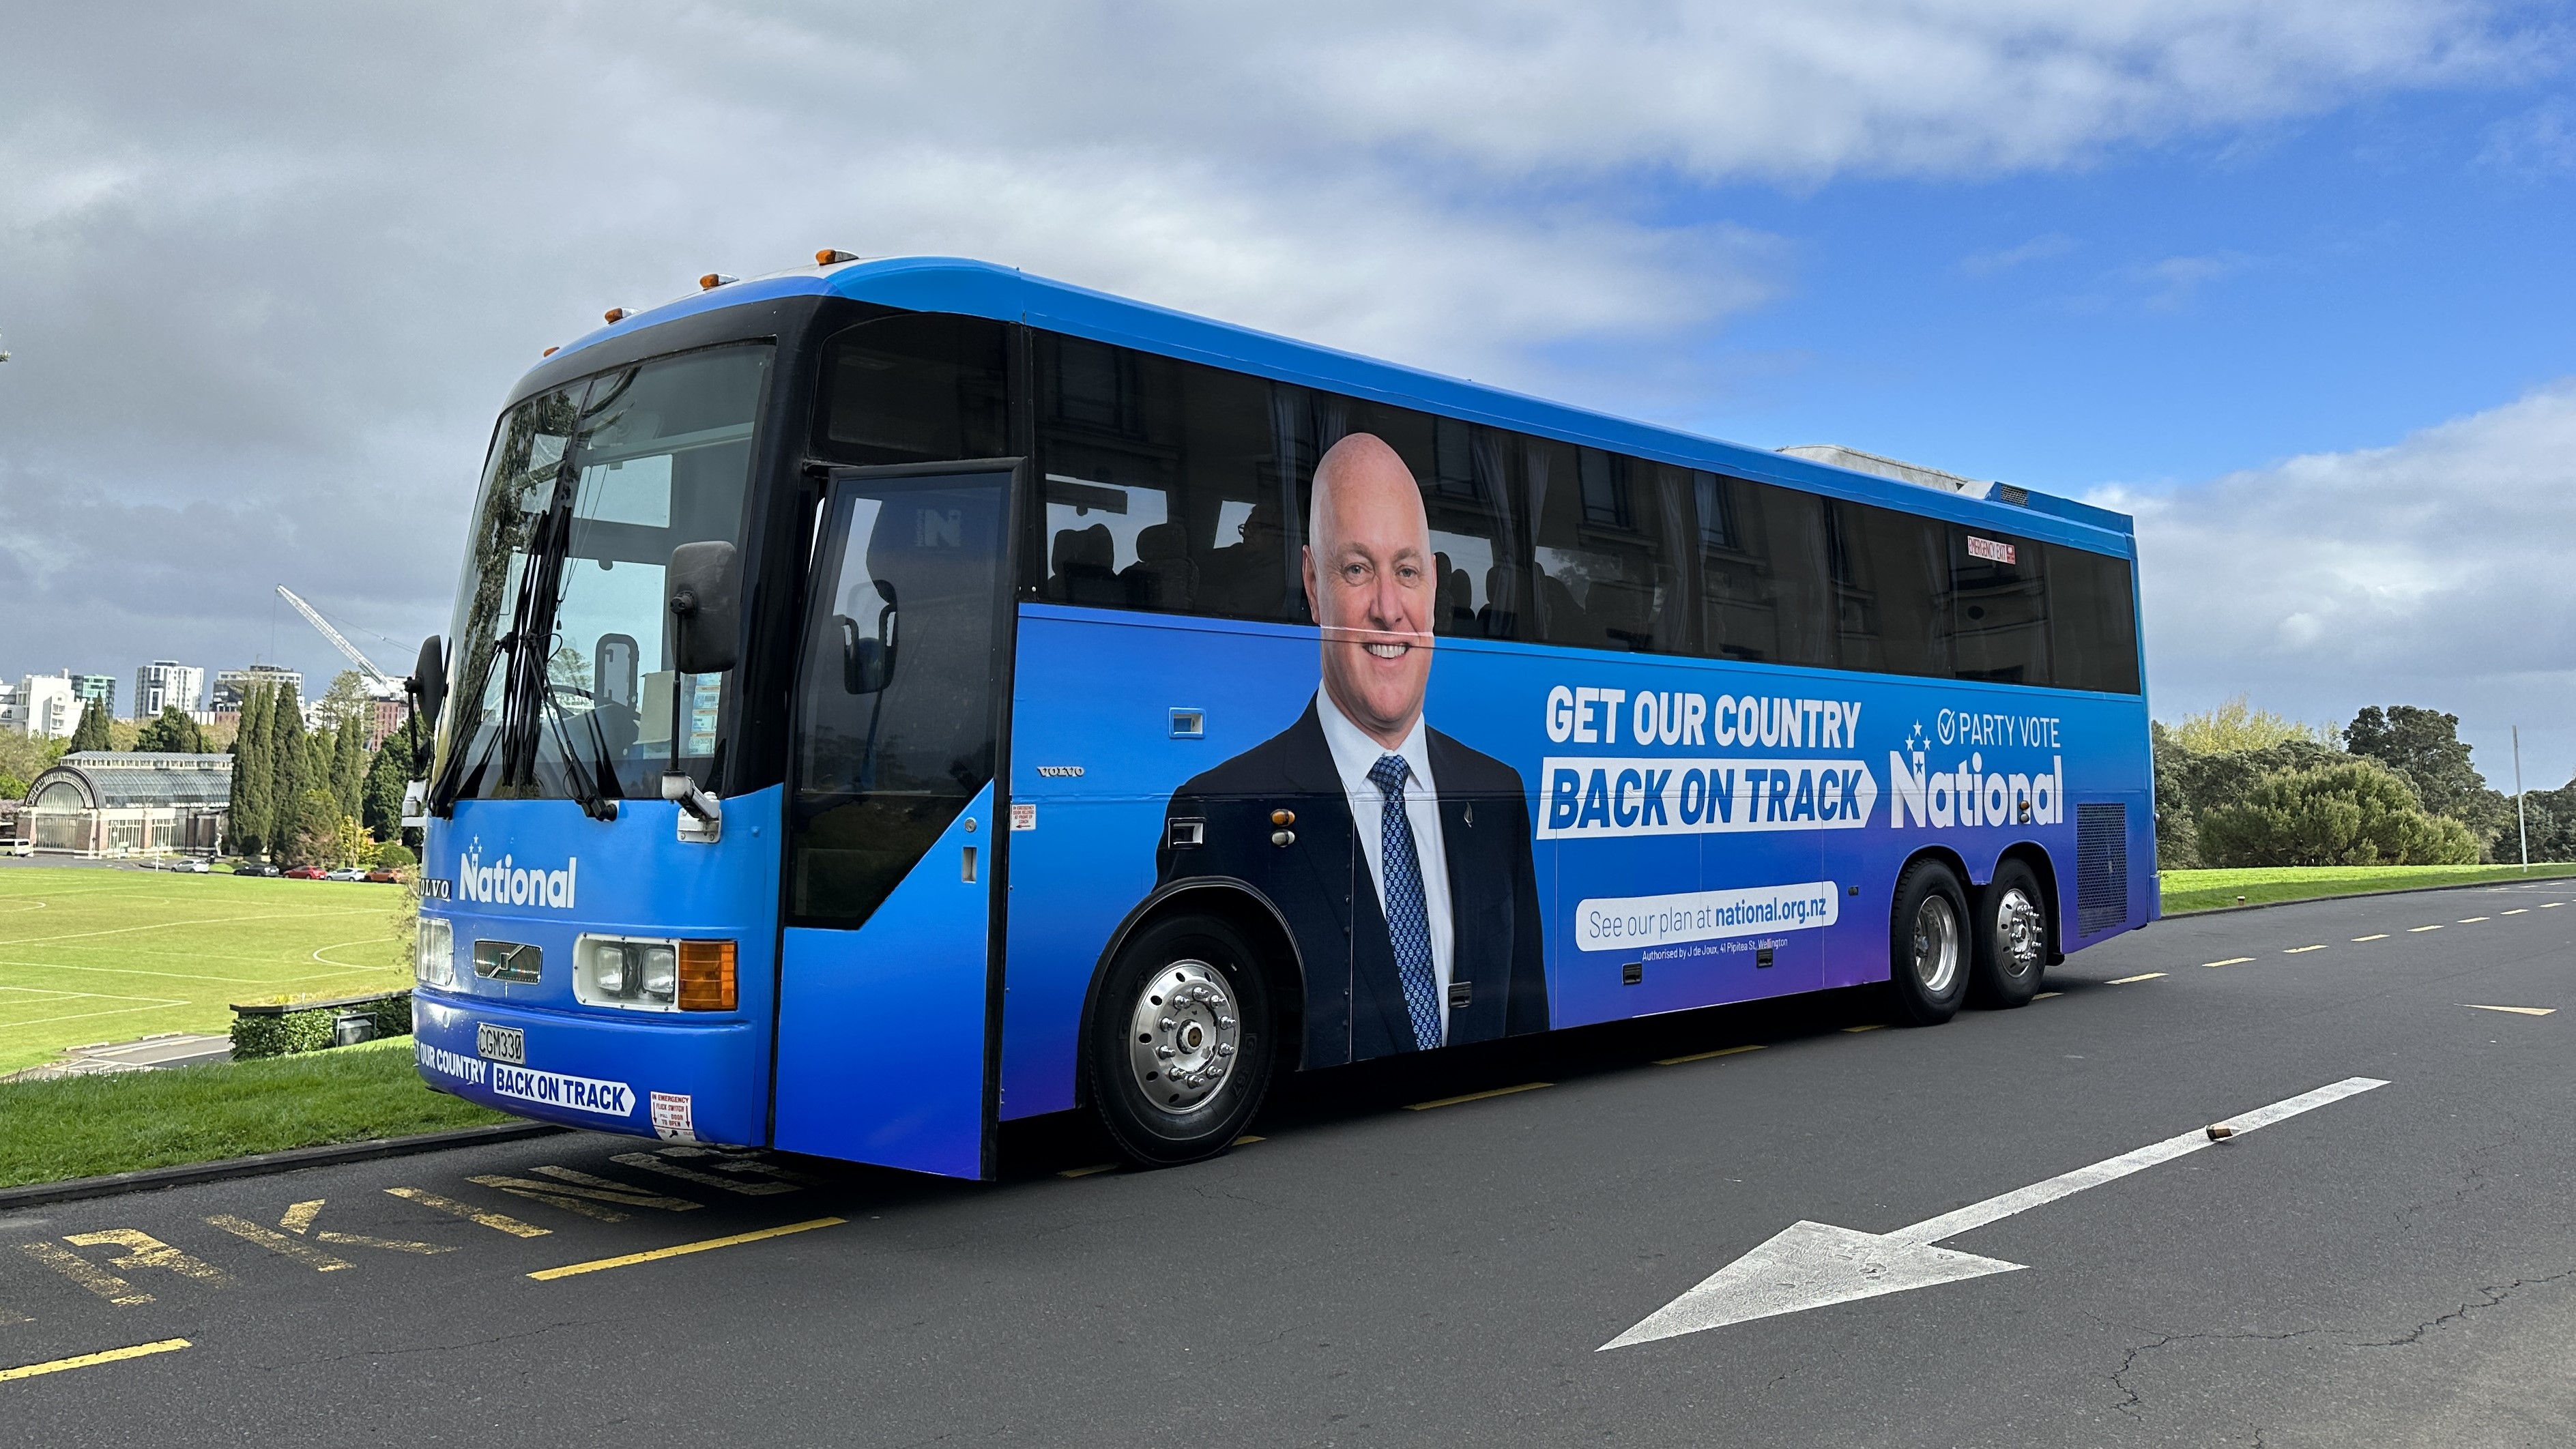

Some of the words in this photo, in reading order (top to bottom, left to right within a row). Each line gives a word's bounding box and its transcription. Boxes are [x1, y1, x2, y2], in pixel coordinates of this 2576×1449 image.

[1969, 538, 1995, 557] EMERGENCY
[1997, 543, 2006, 559] EXIT
[1546, 685, 1625, 744] GET
[1633, 690, 1706, 746] OUR
[1714, 694, 1862, 748] COUNTRY
[1959, 712, 2014, 746] PARTY
[2019, 716, 2061, 748] VOTE
[1037, 766, 1085, 777] VOLVO
[1890, 750, 2063, 829] National
[1548, 768, 1672, 830] BACK
[1679, 768, 1735, 825] ON
[1745, 769, 1863, 823] TRACK
[459, 853, 577, 909] National
[1589, 911, 1622, 938] See
[1627, 915, 1655, 935] our
[1660, 907, 1692, 939] plan
[1697, 908, 1711, 928] at
[1716, 897, 1826, 926] national.org.nz
[1642, 948, 1678, 961] Authorised
[1679, 948, 1686, 959] by
[1688, 947, 1692, 956] J
[1694, 946, 1701, 956] de
[1702, 945, 1718, 955] Joux,
[1720, 943, 1726, 953] 41
[1727, 941, 1748, 956] Pipitea
[1757, 938, 1788, 950] Wellington
[420, 1042, 435, 1069] OUR
[437, 1049, 487, 1084] COUNTRY
[479, 1028, 522, 1059] CGM330
[497, 1068, 534, 1098] BACK
[538, 1076, 559, 1101] ON
[564, 1080, 626, 1112] TRACK
[659, 1095, 689, 1103] EMERGENCY
[0, 1146, 829, 1323] RKING
